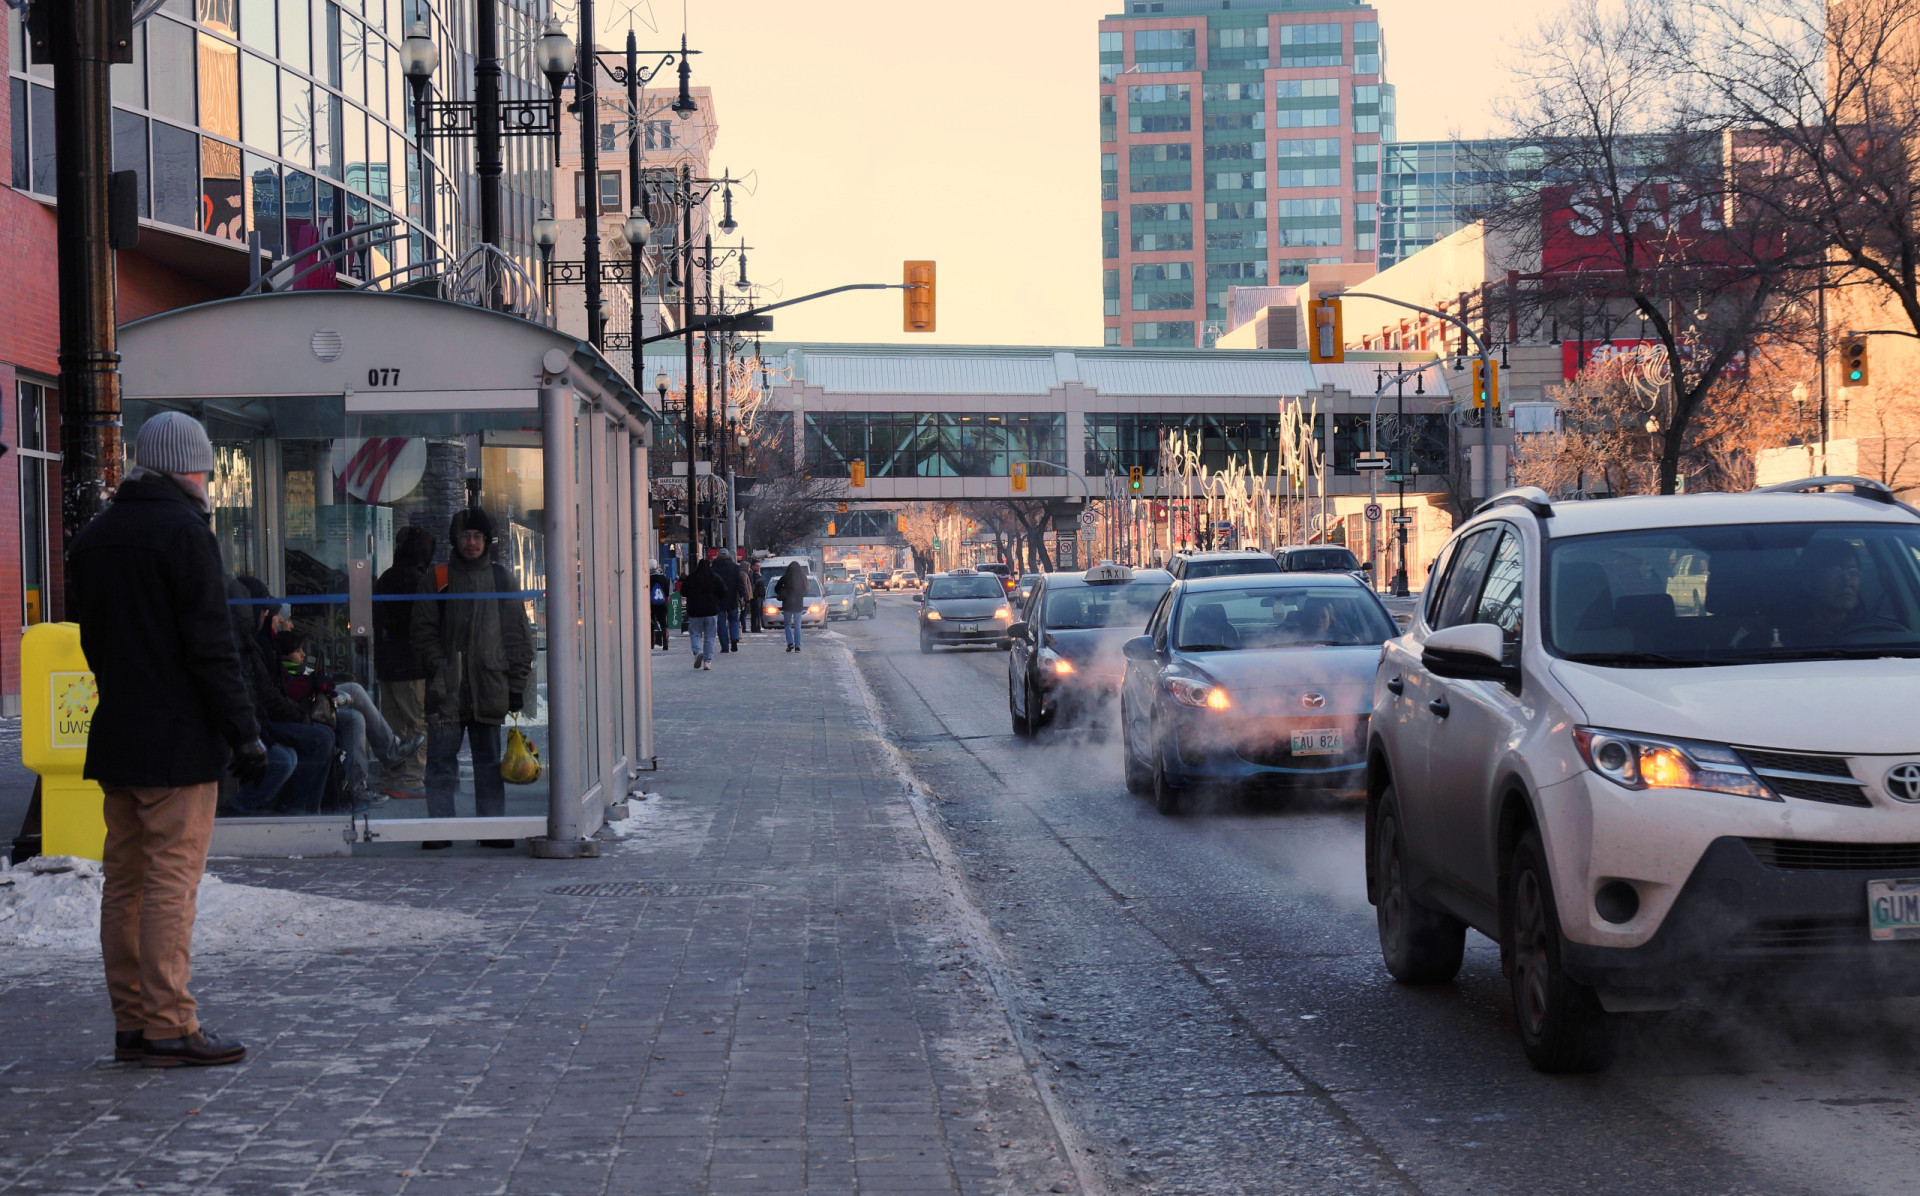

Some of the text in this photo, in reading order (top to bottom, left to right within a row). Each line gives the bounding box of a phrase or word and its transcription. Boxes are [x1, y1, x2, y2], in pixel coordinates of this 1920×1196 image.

[368, 368, 401, 387] 077
[1101, 569, 1125, 579] TAXI
[334, 574, 347, 672] PANOS
[1876, 895, 1920, 923] GUM
